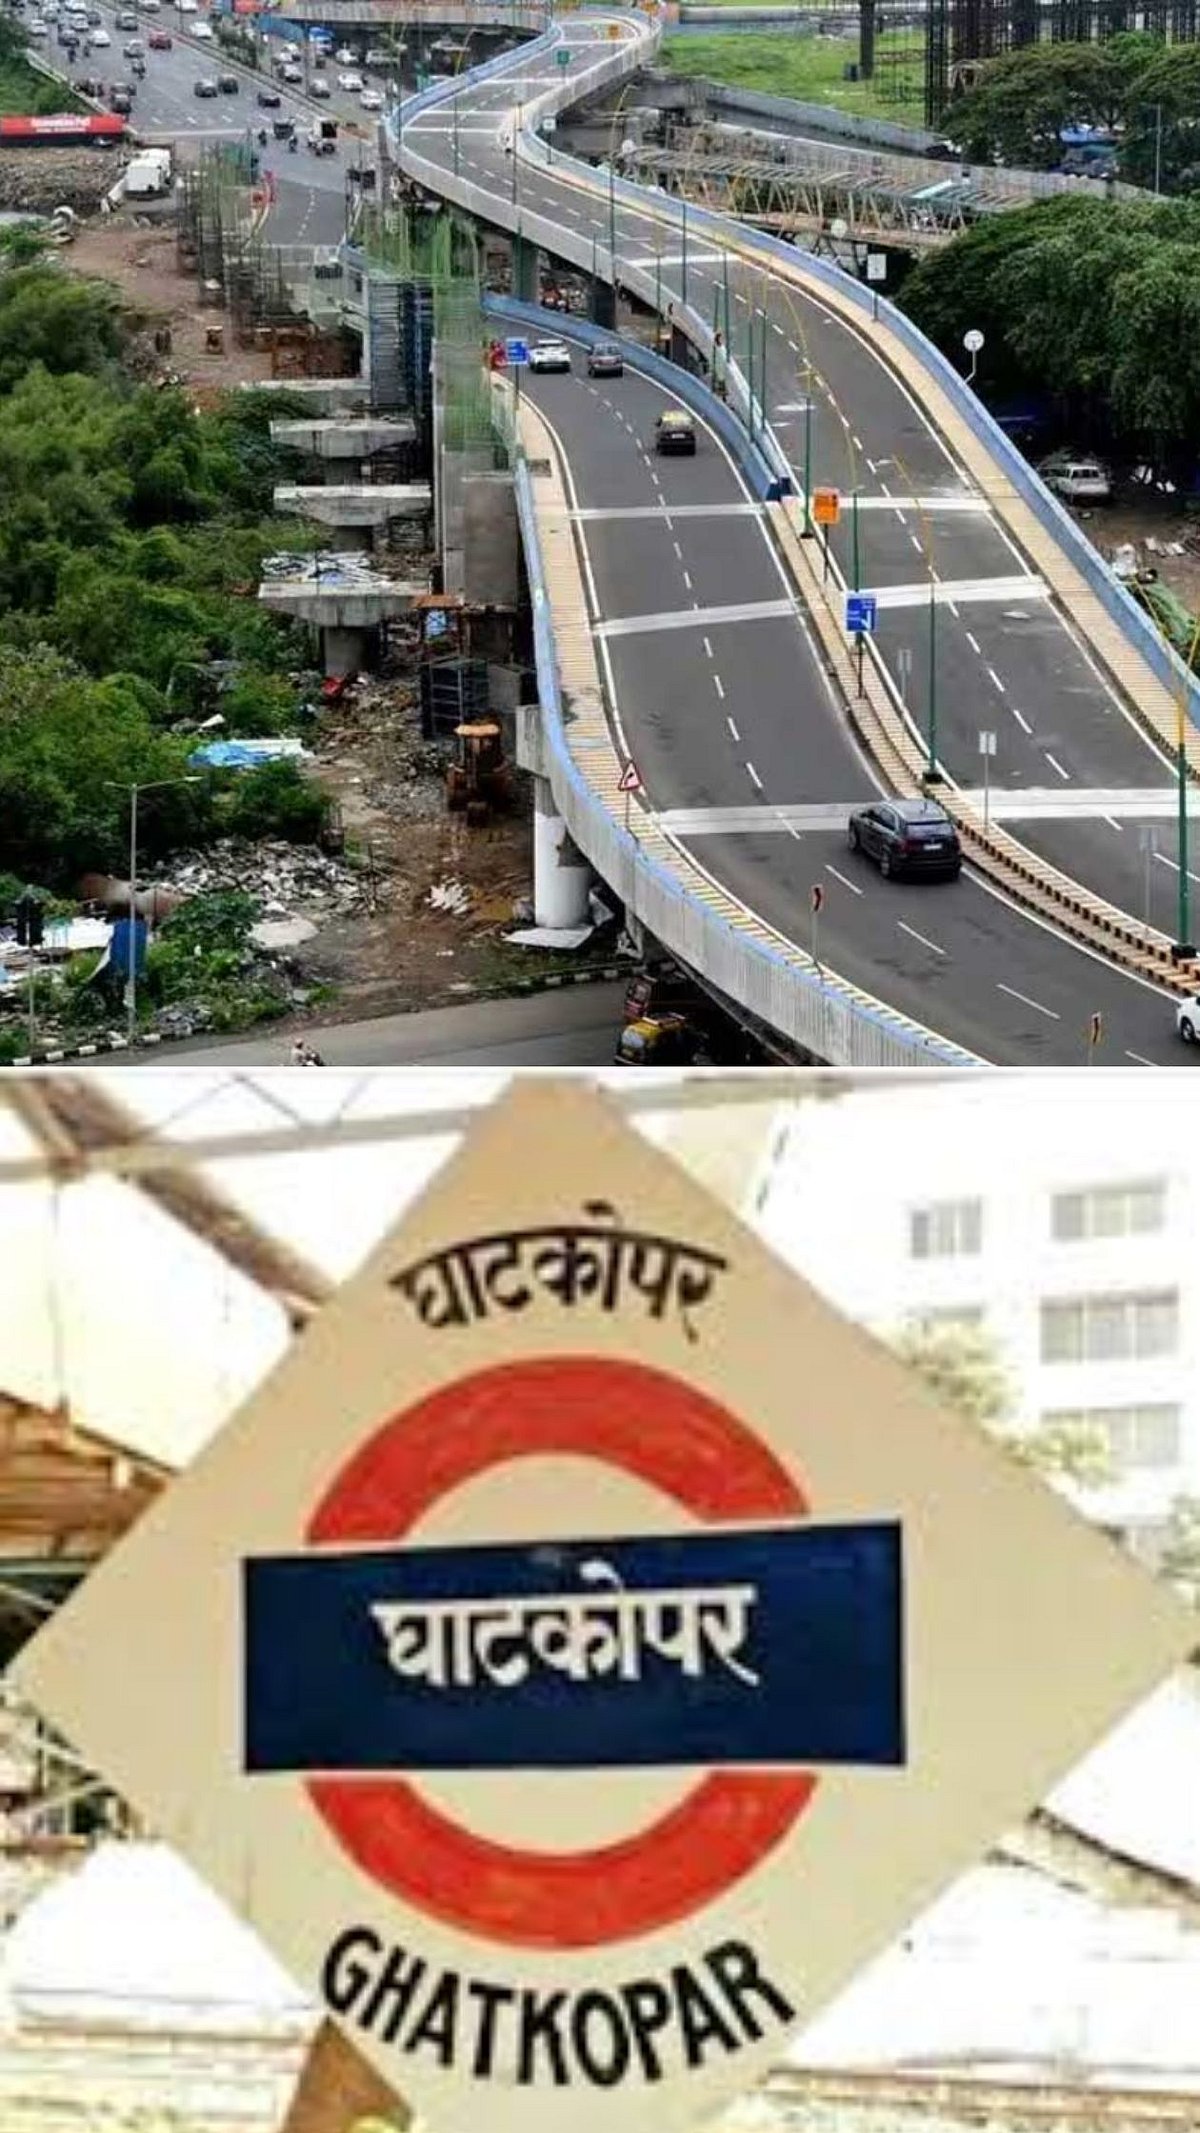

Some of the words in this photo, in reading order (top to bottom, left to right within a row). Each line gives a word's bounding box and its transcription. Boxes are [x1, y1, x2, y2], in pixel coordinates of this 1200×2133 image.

[387, 1199, 729, 1344] घाटकोपर
[371, 1560, 760, 1687] घाटकोपर
[321, 1925, 797, 2088] GHATKOPAR
